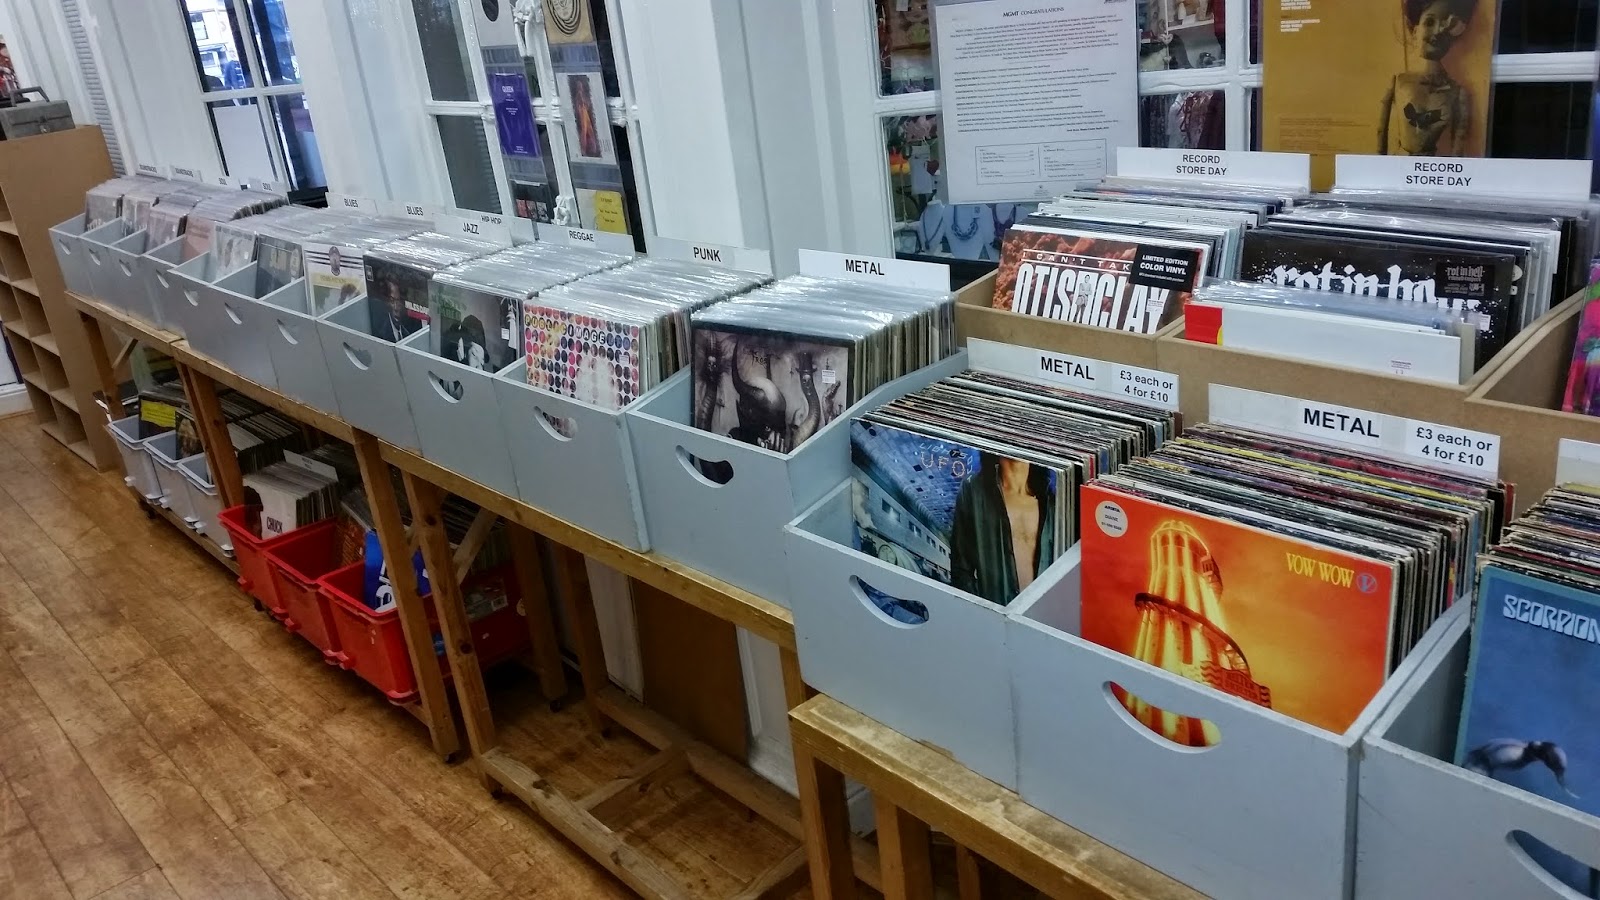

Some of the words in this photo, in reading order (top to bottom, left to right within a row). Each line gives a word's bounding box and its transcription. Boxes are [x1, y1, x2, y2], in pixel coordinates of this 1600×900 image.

[1020, 7, 1065, 16] CONGRATULATIONS
[1182, 154, 1220, 164] RECORD
[1176, 165, 1206, 175] STORE
[1208, 166, 1227, 176] DAY
[1414, 162, 1463, 173] RECORD
[262, 182, 273, 192] SOUL
[1406, 175, 1444, 186] STORE
[1447, 176, 1472, 187] DAY
[344, 198, 359, 208] BLUES
[406, 205, 424, 217] BLUES
[481, 214, 490, 224] HIP
[491, 216, 502, 225] HOP
[463, 222, 480, 235] JAZZ
[569, 230, 595, 242] REGGAE
[694, 247, 721, 262] PUNK
[1036, 253, 1086, 265] CAN'T
[1098, 261, 1132, 271] TAK
[1142, 254, 1164, 263] LIMITED
[1165, 258, 1189, 266] EDITION
[845, 259, 885, 276] METAL
[1140, 262, 1165, 272] COLOR
[1165, 265, 1187, 275] VINYL
[1460, 266, 1468, 276] in
[1011, 263, 1076, 324] OTIS
[525, 314, 568, 336] PUBLIC
[568, 324, 606, 345] IMAGE
[1041, 356, 1095, 381] METAL
[1120, 370, 1132, 381] £3
[1134, 374, 1159, 387] each
[1162, 381, 1173, 390] or
[1124, 385, 1131, 394] 4
[1133, 387, 1148, 398] for
[1150, 391, 1169, 403] £10
[1304, 408, 1380, 438] METAL
[1416, 427, 1433, 440] £3
[1437, 432, 1472, 448] each
[1476, 440, 1493, 451] or
[919, 442, 968, 460] LIGHTS
[1422, 445, 1430, 456] 4
[1434, 447, 1455, 460] for
[1458, 452, 1484, 466] £10
[921, 451, 965, 477] UFO
[266, 516, 283, 534] CHUCK
[1286, 552, 1317, 578] VOW
[1319, 561, 1355, 588] WOW
[1502, 594, 1600, 645] SCORPION
